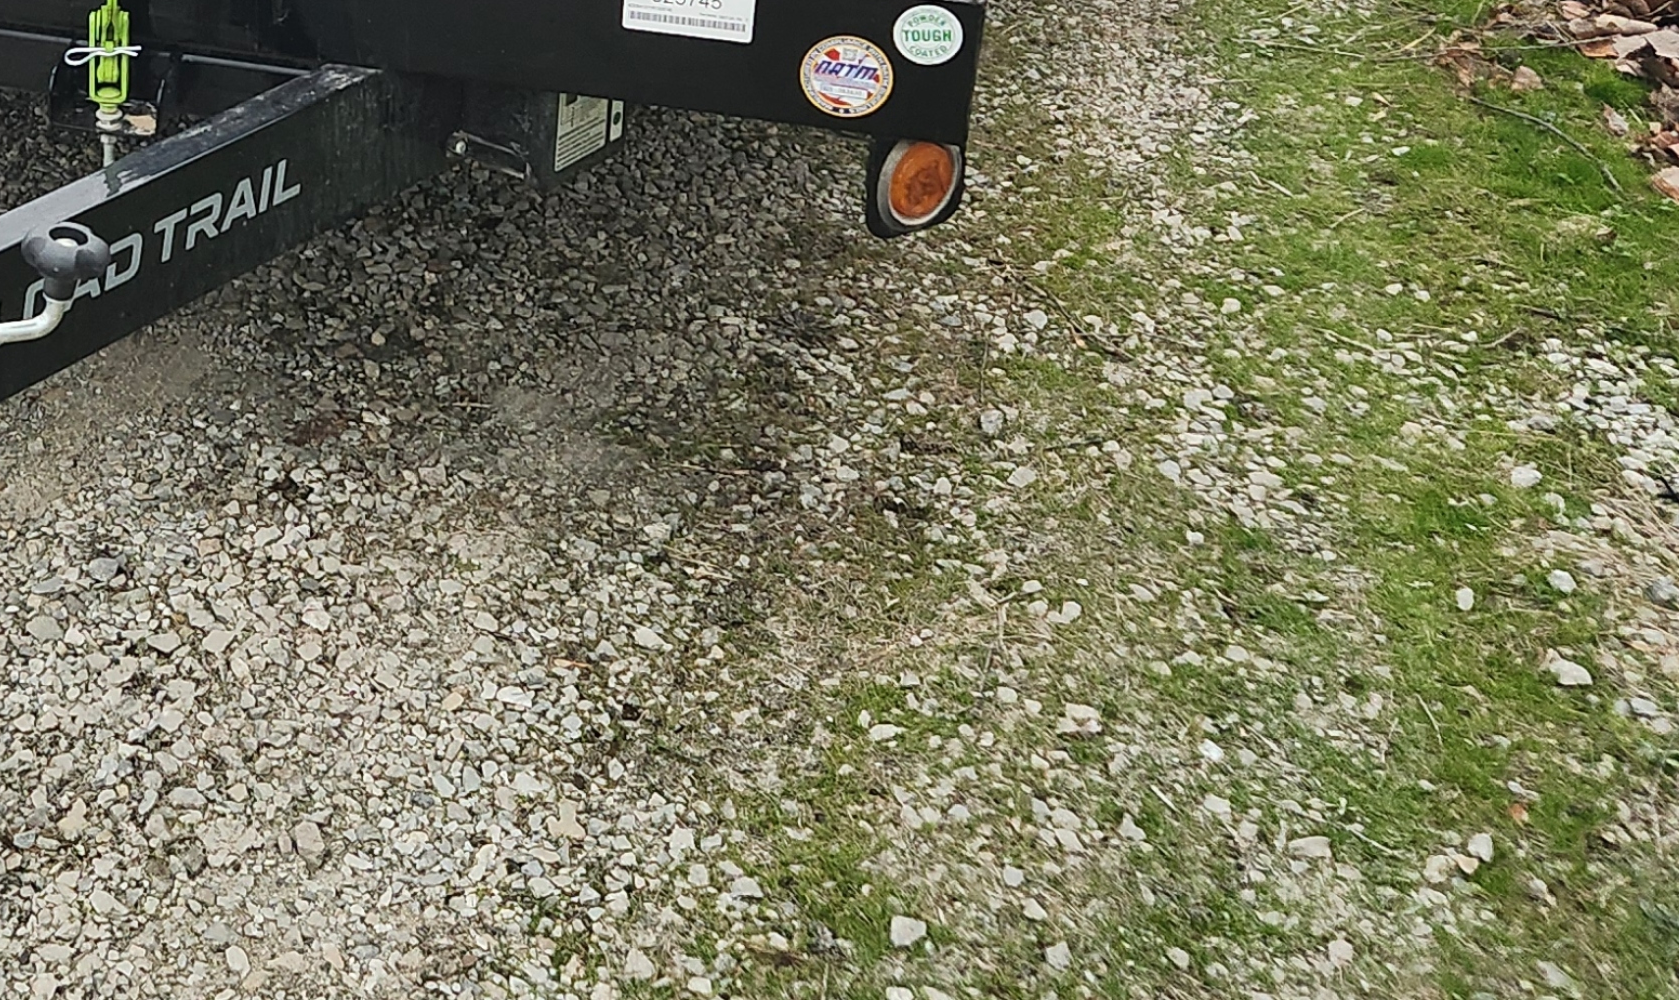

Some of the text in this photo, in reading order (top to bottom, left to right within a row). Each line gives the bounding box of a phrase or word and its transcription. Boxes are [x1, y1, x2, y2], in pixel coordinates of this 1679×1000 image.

[902, 29, 952, 42] TOUGH
[909, 45, 948, 57] COATED
[154, 158, 301, 263] TRAIL
